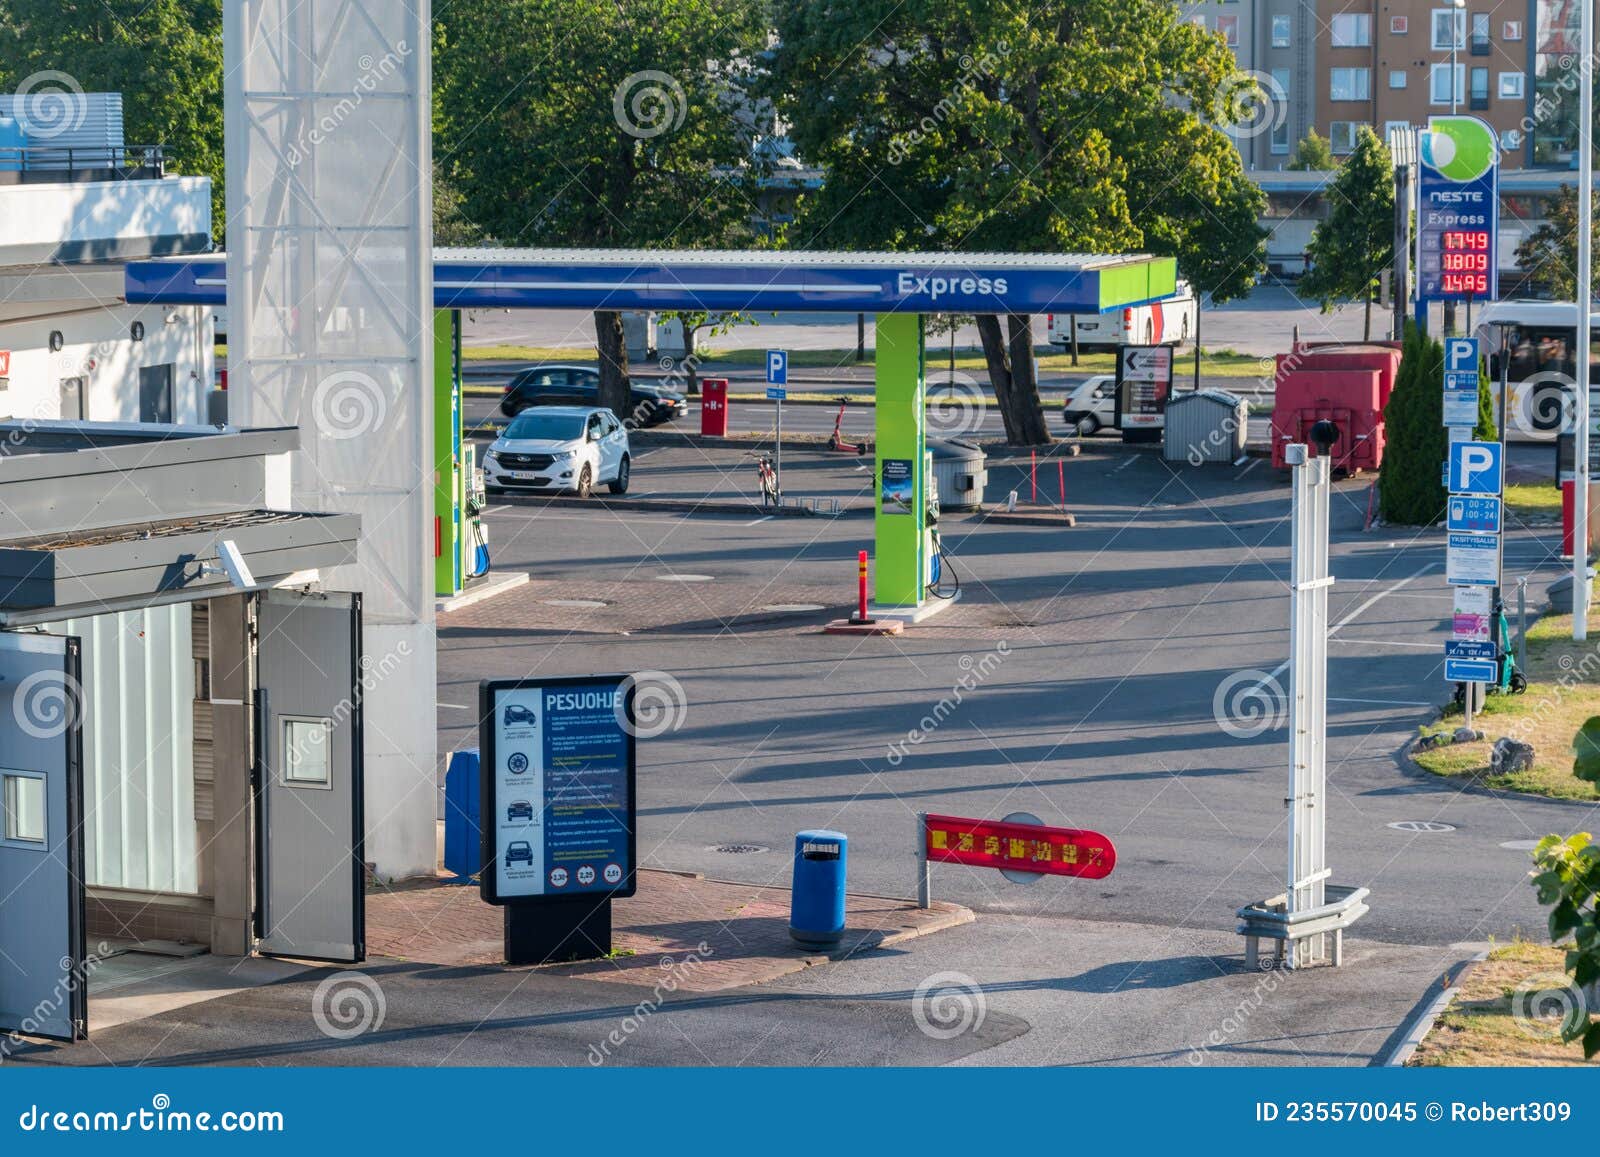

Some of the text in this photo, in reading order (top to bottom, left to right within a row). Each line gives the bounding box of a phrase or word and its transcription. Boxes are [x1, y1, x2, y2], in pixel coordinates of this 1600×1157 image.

[1430, 191, 1484, 202] NESTE
[1428, 212, 1485, 227] Express
[898, 272, 1008, 300] Express
[770, 353, 784, 381] P
[1451, 341, 1474, 370] P
[1460, 446, 1493, 489] P
[546, 692, 622, 711] PESUOHJE
